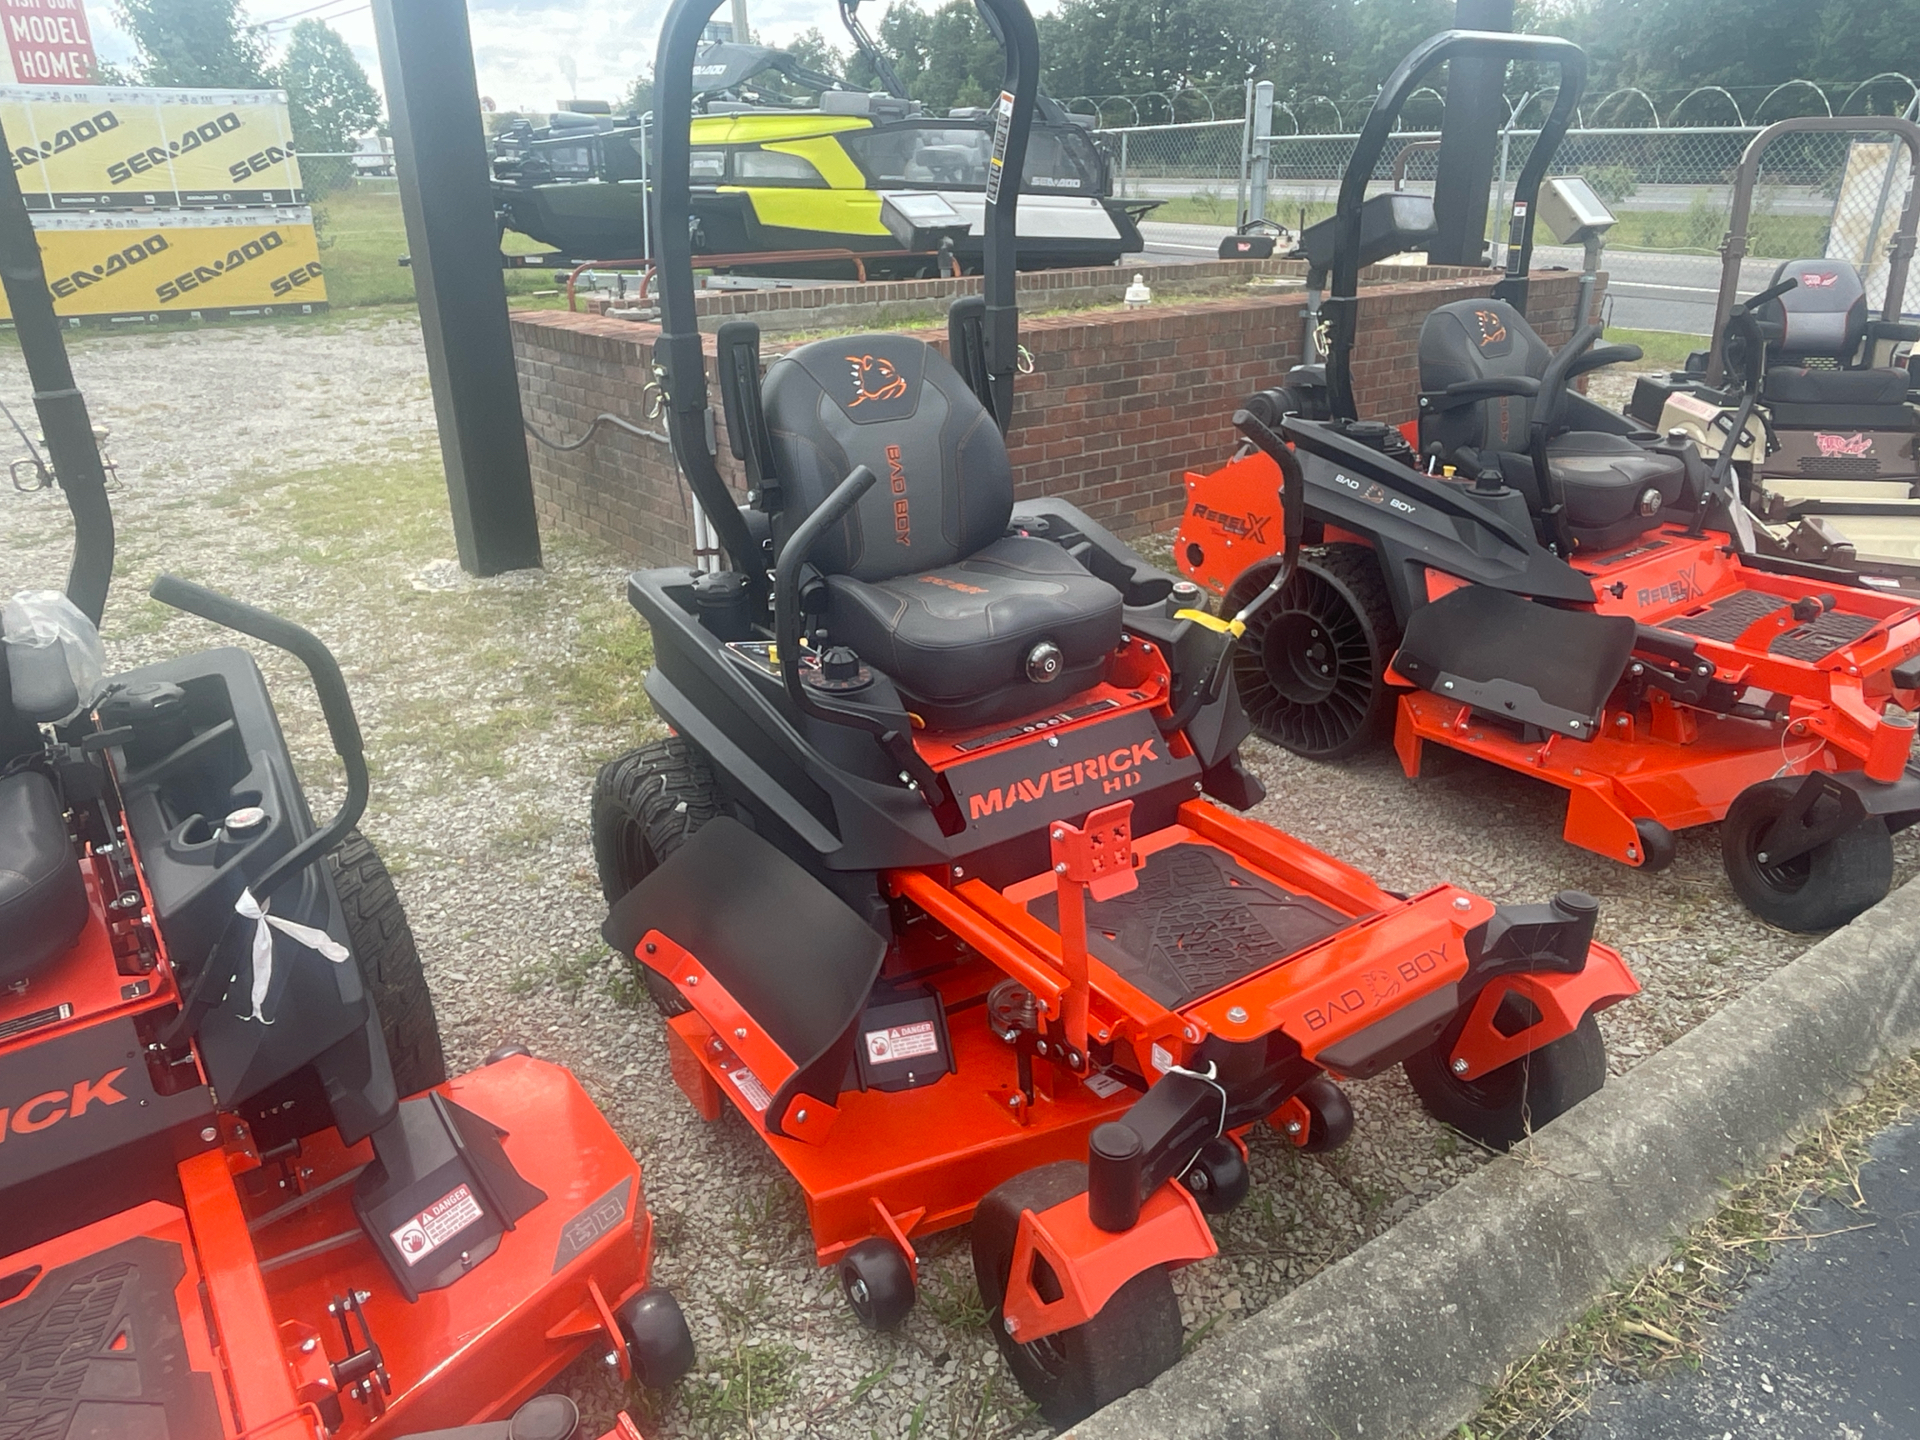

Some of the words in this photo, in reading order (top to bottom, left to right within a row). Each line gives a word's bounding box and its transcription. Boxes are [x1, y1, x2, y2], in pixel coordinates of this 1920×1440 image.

[9, 15, 87, 44] MODEL
[19, 50, 92, 79] HOME!
[886, 445, 907, 494] BAD
[1335, 473, 1360, 490] BAD
[1389, 498, 1416, 514] BOY
[894, 499, 910, 546] BOY
[969, 739, 1159, 820] MAVERICK
[1103, 771, 1142, 795] HD
[1303, 989, 1366, 1032] BAD
[1397, 943, 1449, 982] BOY
[901, 1023, 932, 1036] DANGER
[432, 1188, 468, 1216] DANGER
